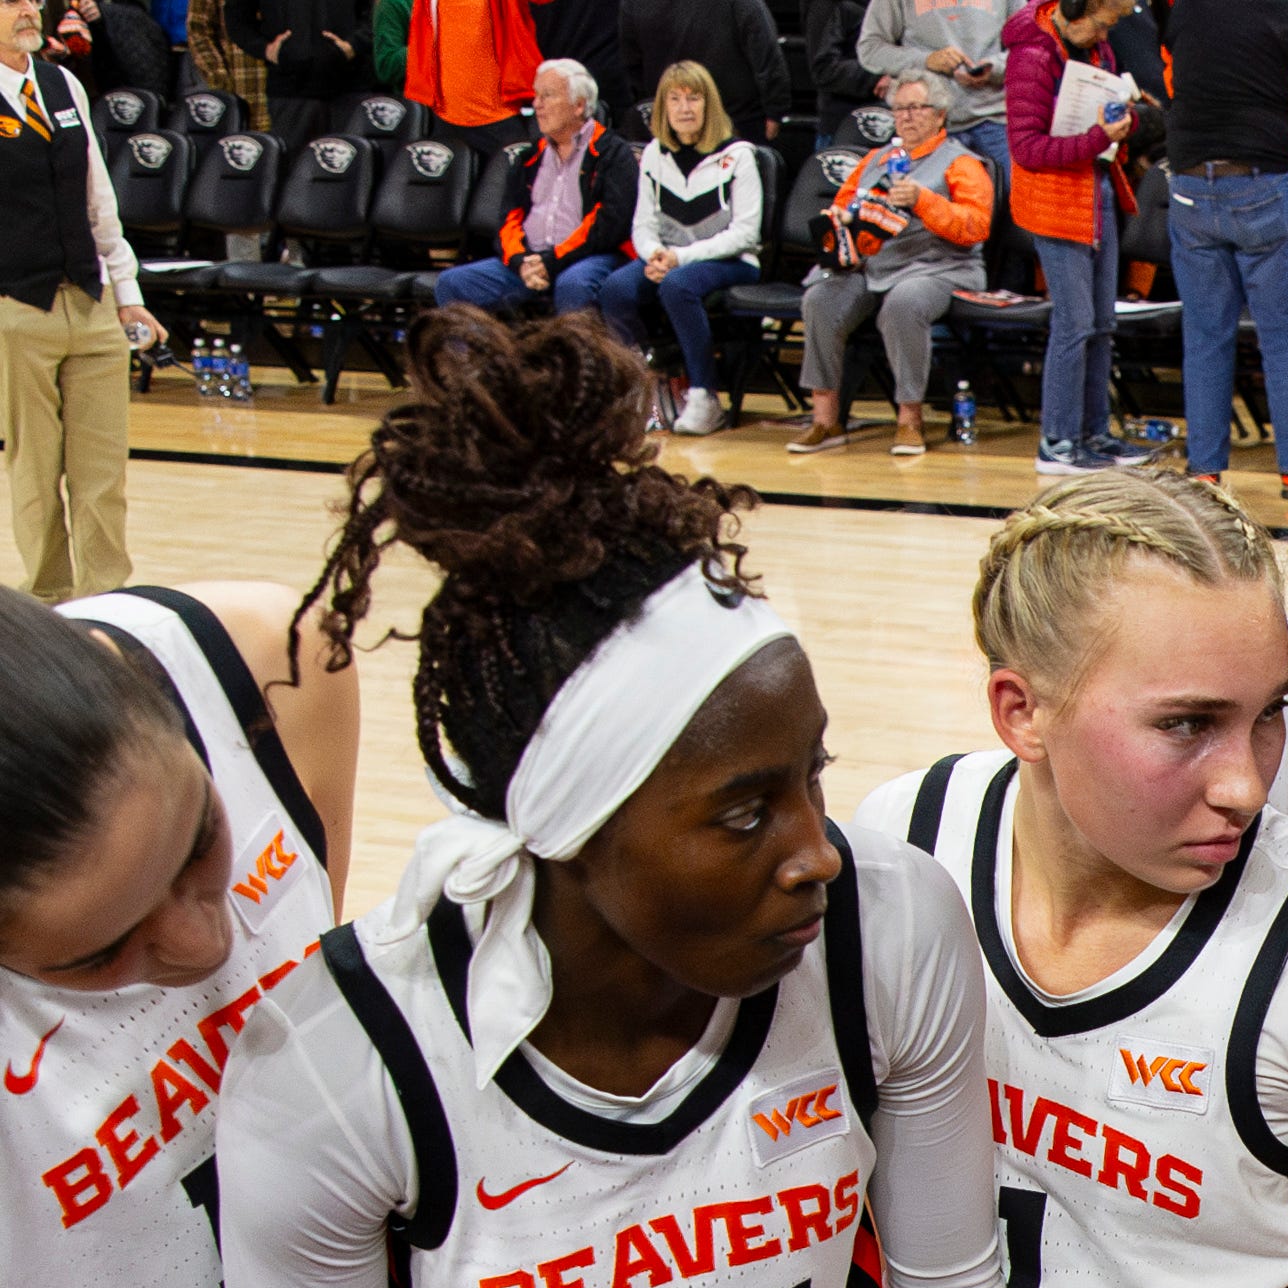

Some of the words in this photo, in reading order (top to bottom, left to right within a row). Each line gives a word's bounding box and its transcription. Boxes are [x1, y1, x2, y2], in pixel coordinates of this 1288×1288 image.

[232, 828, 299, 905] WCC
[1118, 1048, 1209, 1096] WCC
[751, 1083, 844, 1143] WCC
